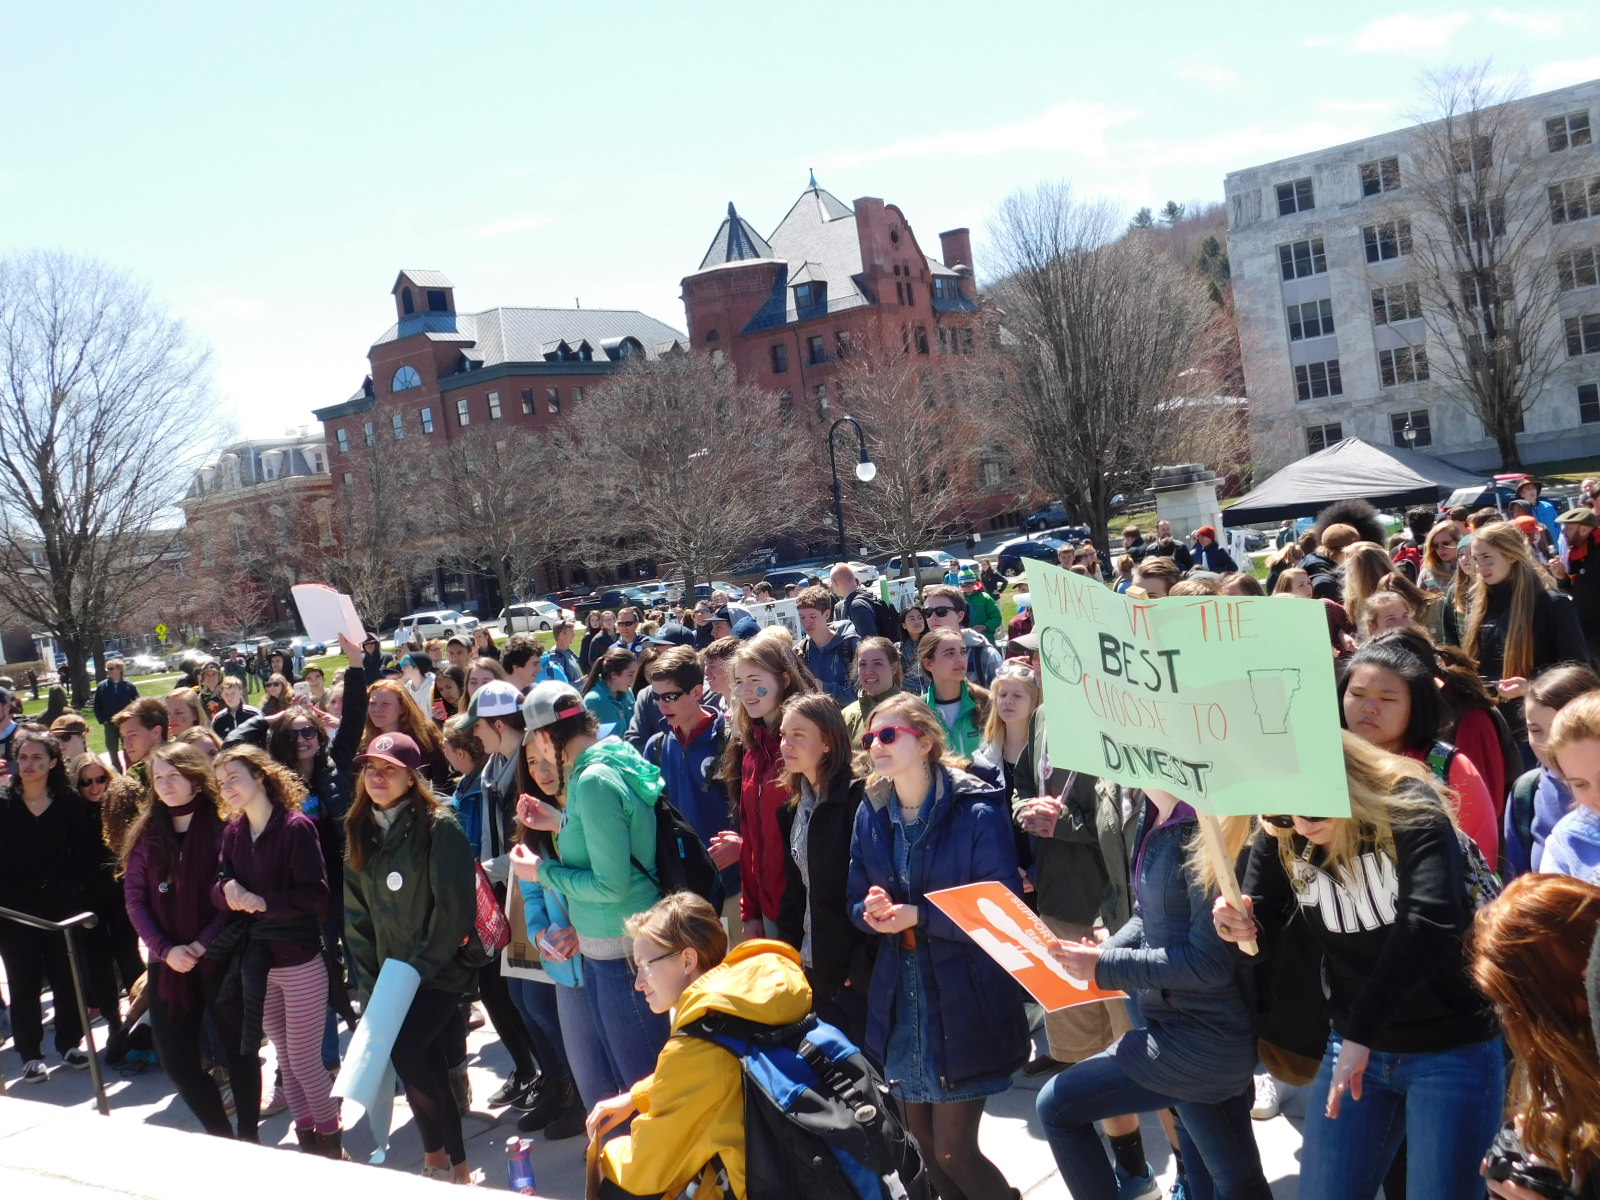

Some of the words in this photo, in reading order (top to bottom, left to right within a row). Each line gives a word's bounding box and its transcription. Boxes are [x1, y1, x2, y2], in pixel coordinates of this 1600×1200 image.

[1043, 572, 1104, 625] MAKE
[1126, 601, 1158, 641] IT
[1184, 599, 1258, 643] THE
[1098, 631, 1181, 694] BEST
[1082, 673, 1170, 737] CHOOSE
[1179, 701, 1229, 745] TO
[1099, 731, 1213, 798] DIVEST
[1009, 895, 1058, 944] SUPPORT
